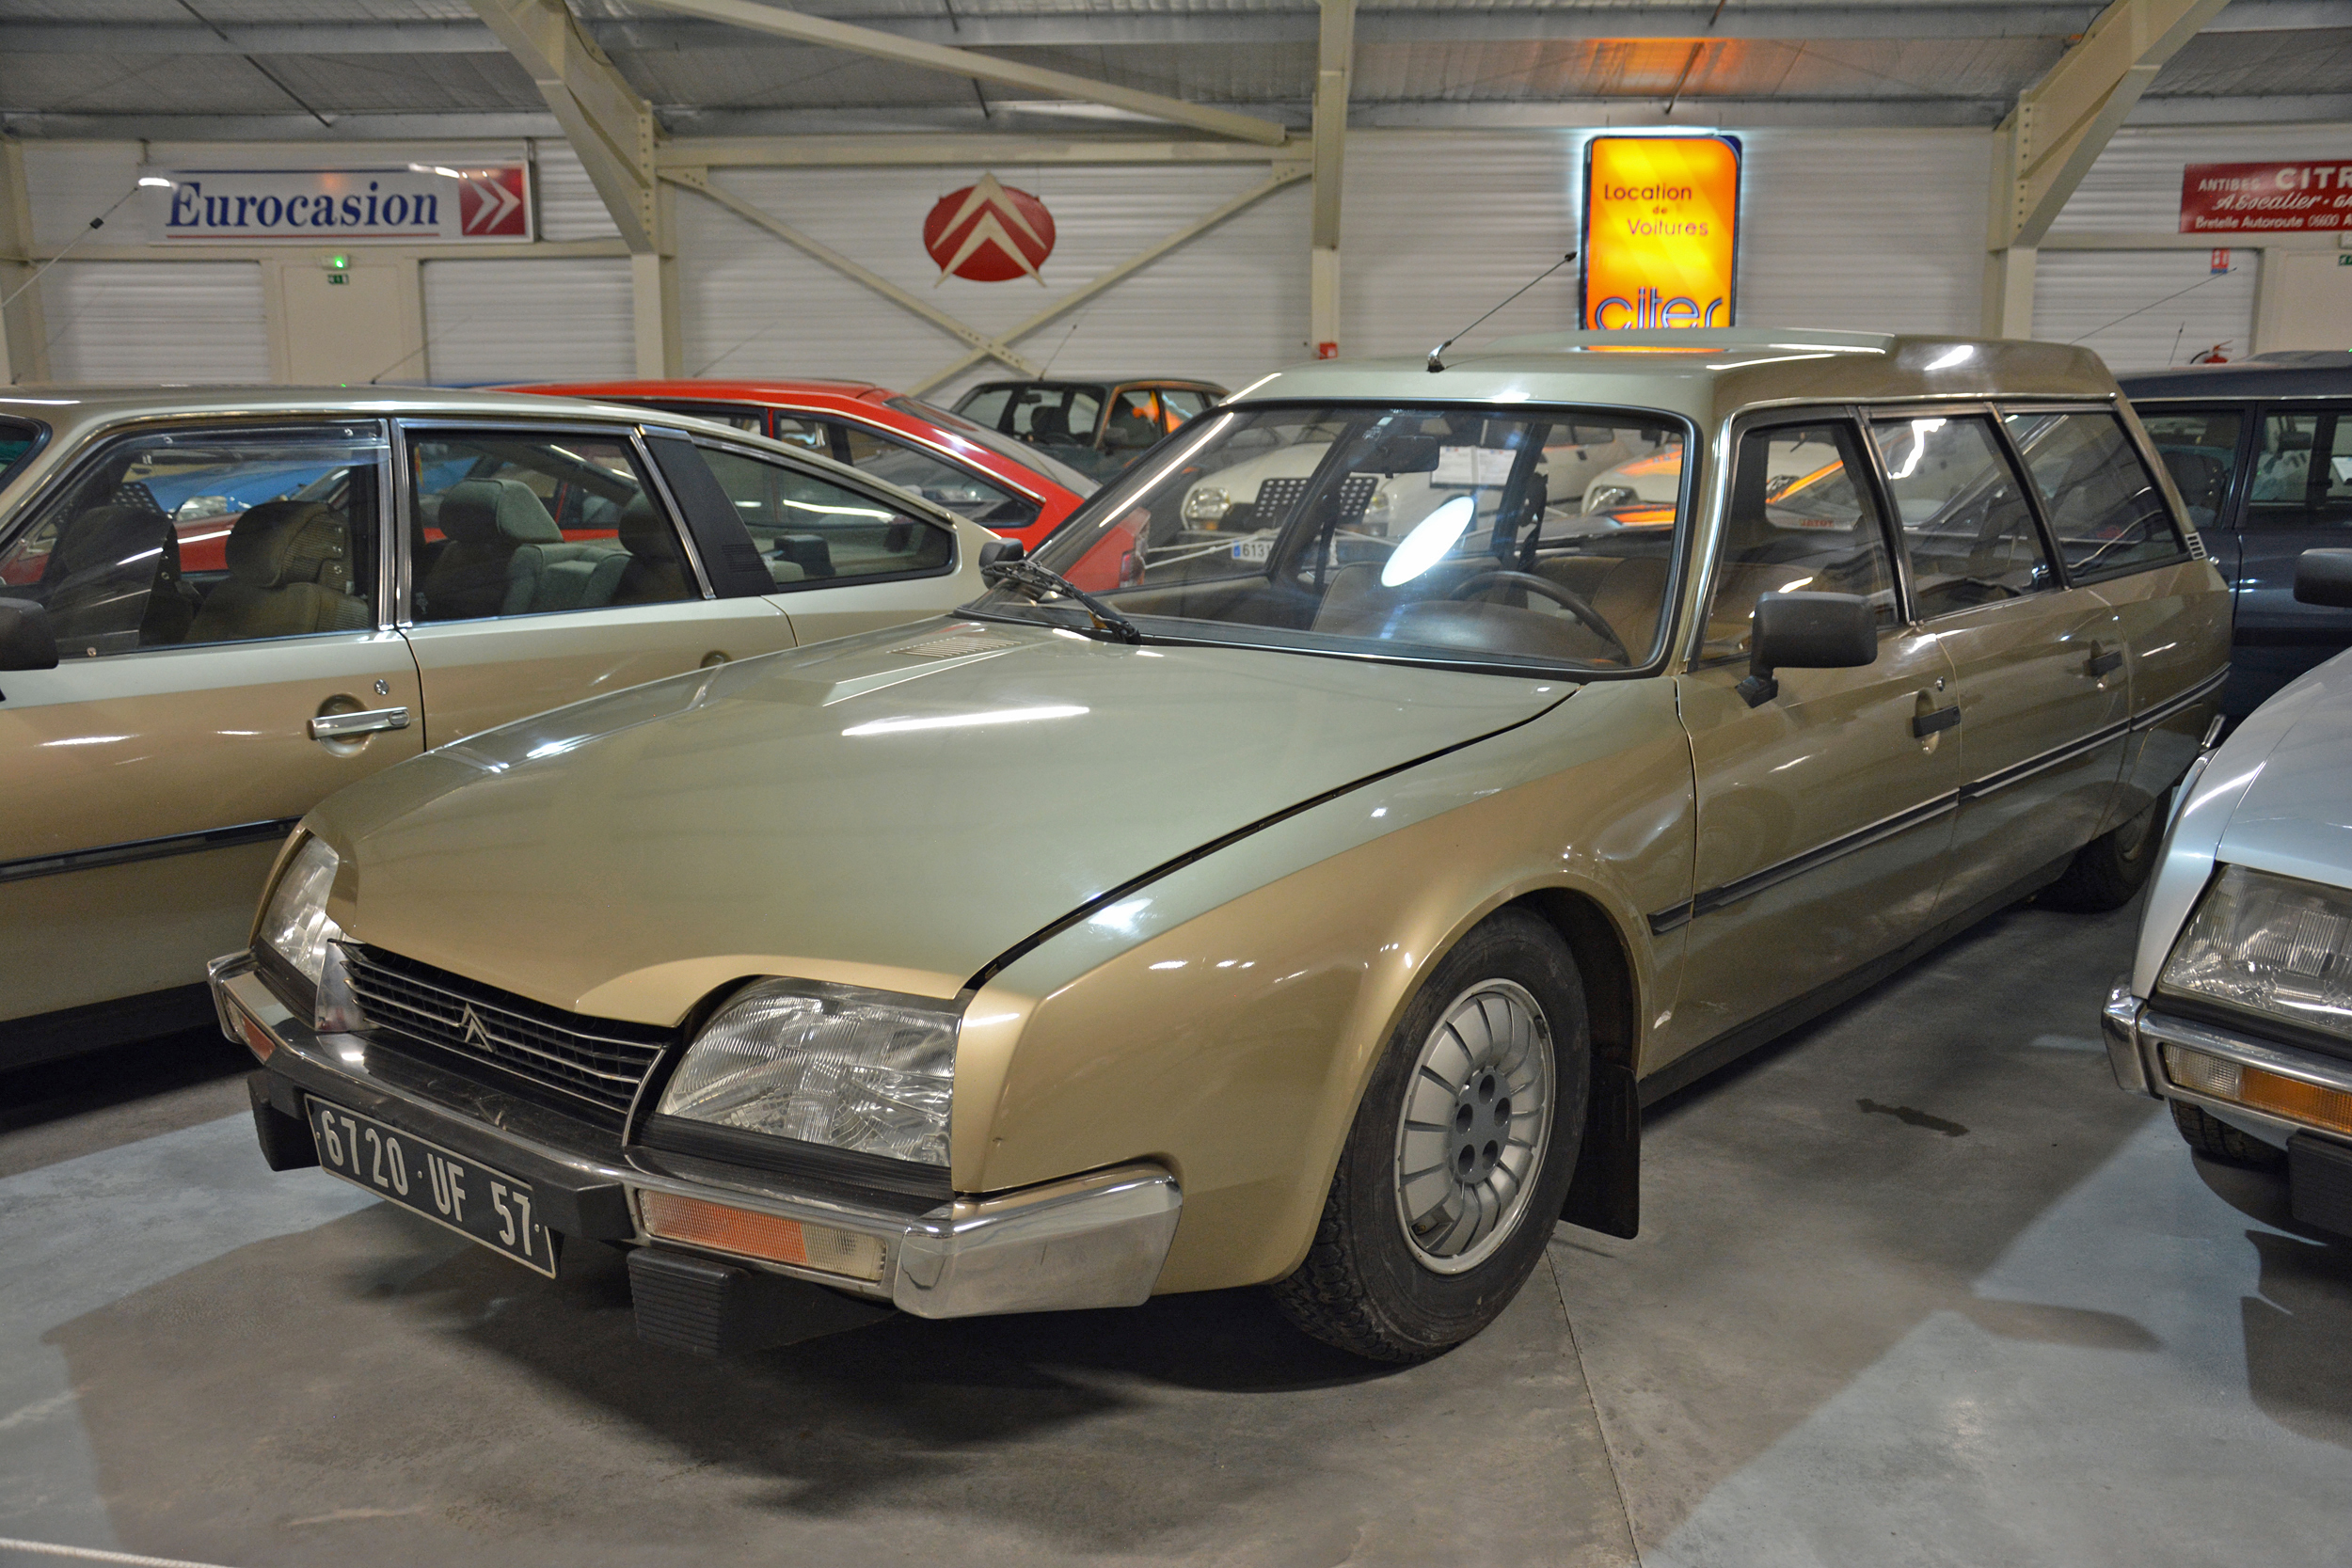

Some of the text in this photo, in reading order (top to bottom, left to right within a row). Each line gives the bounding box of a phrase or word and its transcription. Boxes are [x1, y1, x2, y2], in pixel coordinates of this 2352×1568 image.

[1605, 183, 1692, 200] Location
[2198, 178, 2261, 192] ANTIBES
[166, 182, 438, 228] Eurocasion
[1653, 205, 1668, 214] de
[1628, 218, 1708, 236] Voitures
[2195, 215, 2239, 229] Bretelle
[2241, 215, 2304, 228] Autoroute
[1595, 286, 1723, 329] citer
[321, 1110, 532, 1257] 6720 UF 57
